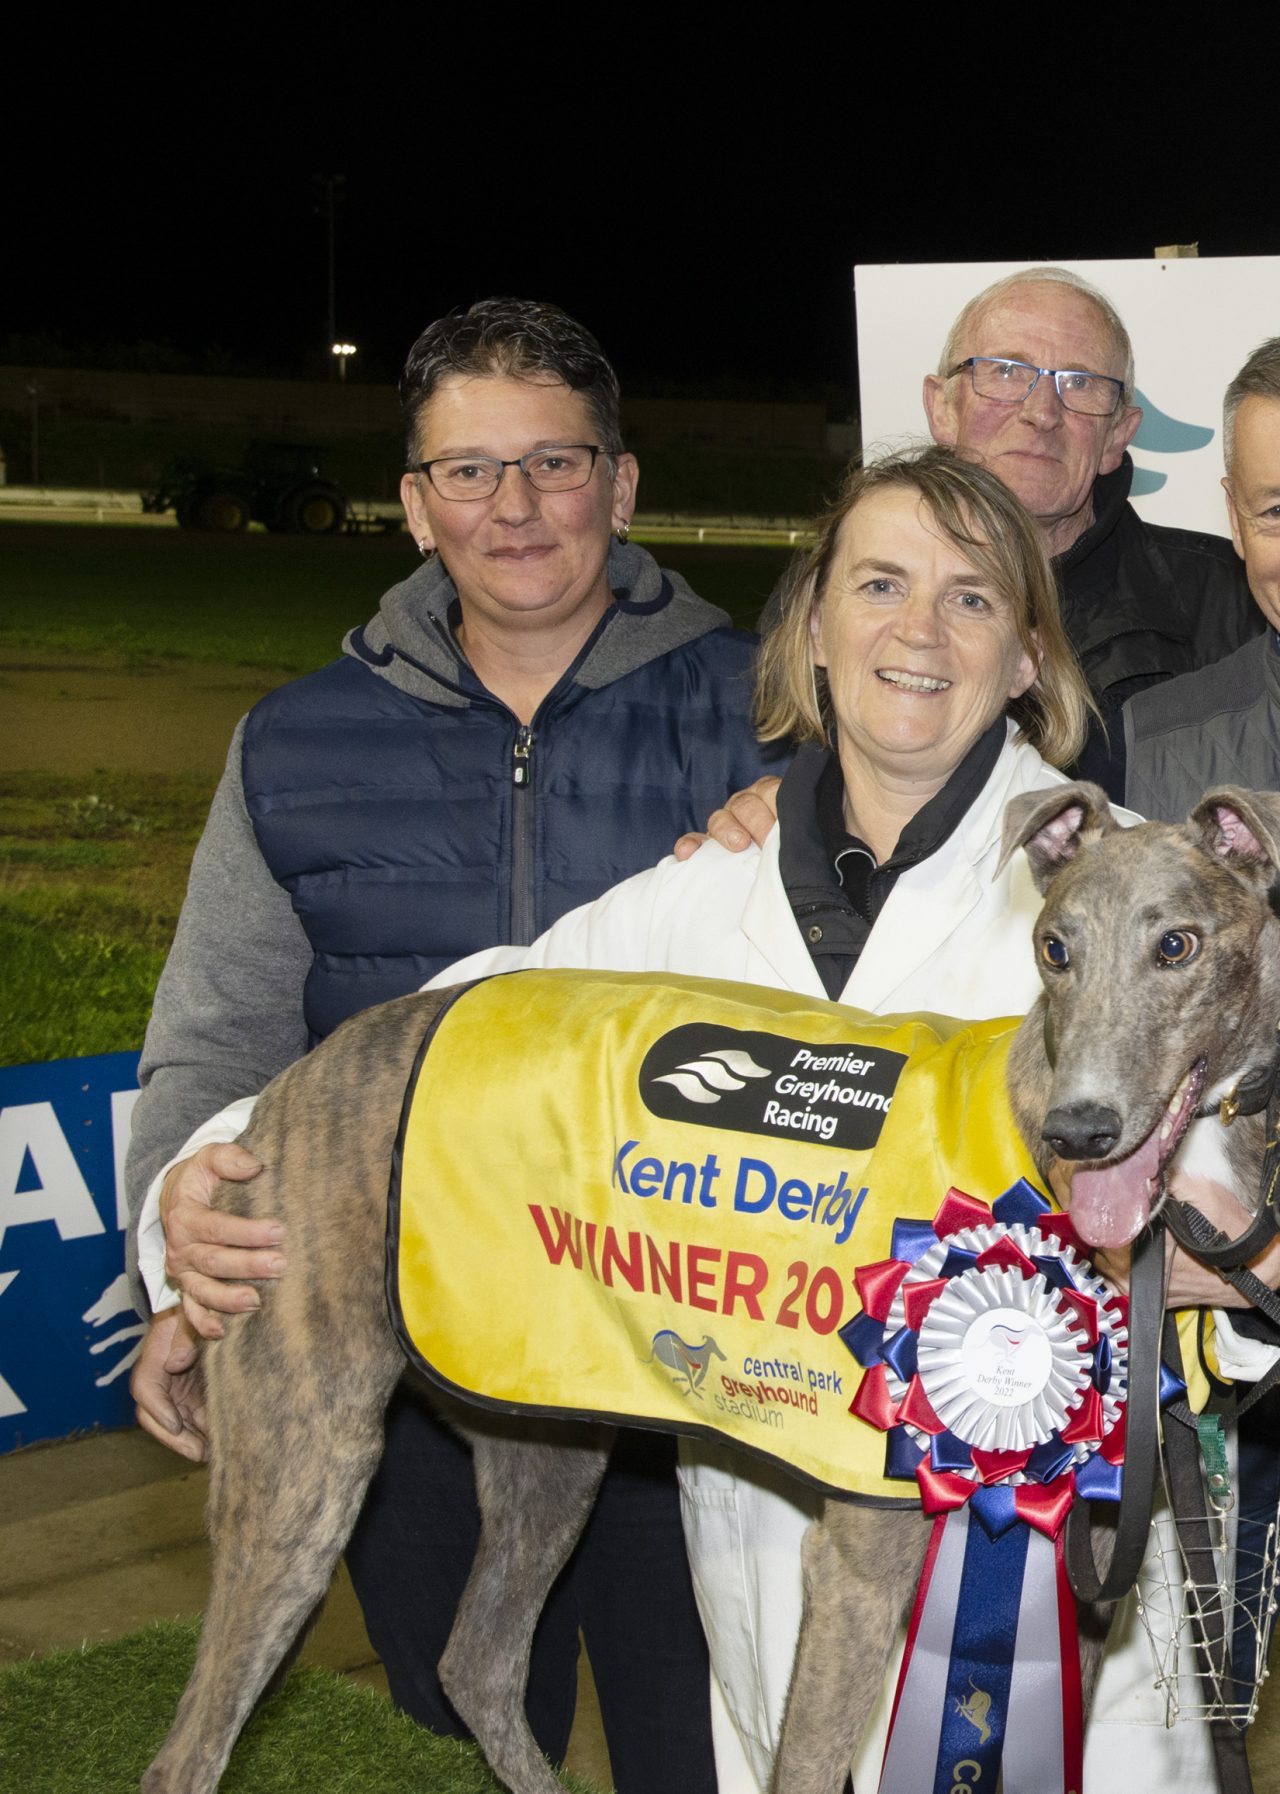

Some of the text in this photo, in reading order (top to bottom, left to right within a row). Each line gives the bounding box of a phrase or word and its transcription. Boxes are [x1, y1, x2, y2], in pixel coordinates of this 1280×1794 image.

[790, 1049, 875, 1076] Premier
[763, 1100, 838, 1140] Racing
[612, 1136, 869, 1244] Kent Derby
[527, 1204, 769, 1321] WINNER
[743, 1357, 843, 1395] central park
[977, 1374, 1032, 1388] Derby Winner
[996, 1366, 1015, 1376] Kent
[721, 1375, 818, 1416] greyhound
[994, 1386, 1014, 1397] 2022
[714, 1393, 784, 1430] stadium
